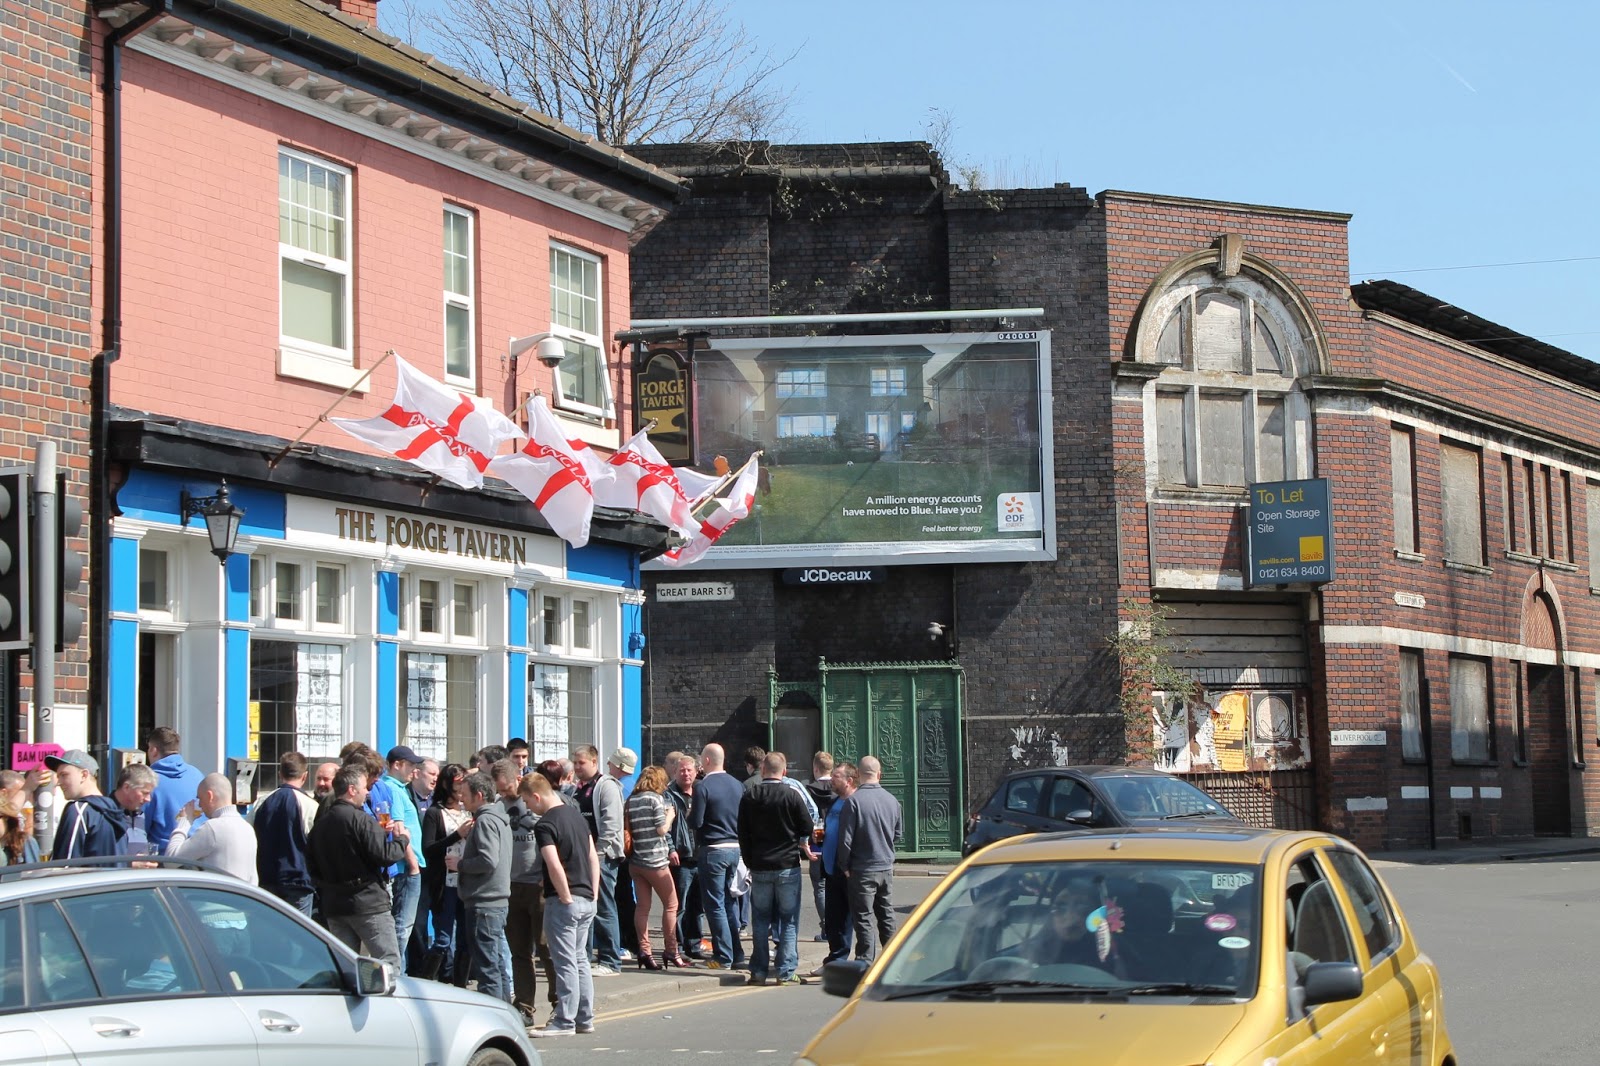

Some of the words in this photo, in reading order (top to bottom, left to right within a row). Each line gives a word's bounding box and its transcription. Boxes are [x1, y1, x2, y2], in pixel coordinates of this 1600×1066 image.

[998, 332, 1036, 340] 040001
[640, 380, 685, 396] FORGE
[641, 395, 685, 408] TAVERN
[627, 452, 687, 499] ENGLAN
[866, 496, 874, 505] A
[875, 496, 906, 505] million
[907, 496, 940, 506] energy
[941, 494, 982, 503] accounts
[1256, 489, 1275, 505] To
[1281, 487, 1304, 503] Let
[842, 507, 865, 516] have
[866, 506, 898, 516] moved
[899, 507, 908, 515] to
[911, 506, 934, 515] Blue.
[935, 505, 959, 514] Have
[960, 504, 983, 516] you?
[1256, 511, 1283, 522] Open
[1285, 509, 1321, 520] Storage
[959, 525, 983, 533] energy
[1257, 523, 1275, 534] Site
[335, 507, 377, 544] THE
[385, 514, 449, 555] FORGE
[453, 526, 527, 566] TAVERN
[1259, 557, 1295, 566] savills.com
[1301, 552, 1323, 561] savills
[800, 569, 872, 583] JCDecaux
[1259, 569, 1279, 579] 0121
[1280, 567, 1298, 577] 634
[1301, 565, 1325, 576] 8400
[660, 587, 688, 597] GREAT
[691, 587, 714, 596] BARR
[17, 750, 36, 763] BAM
